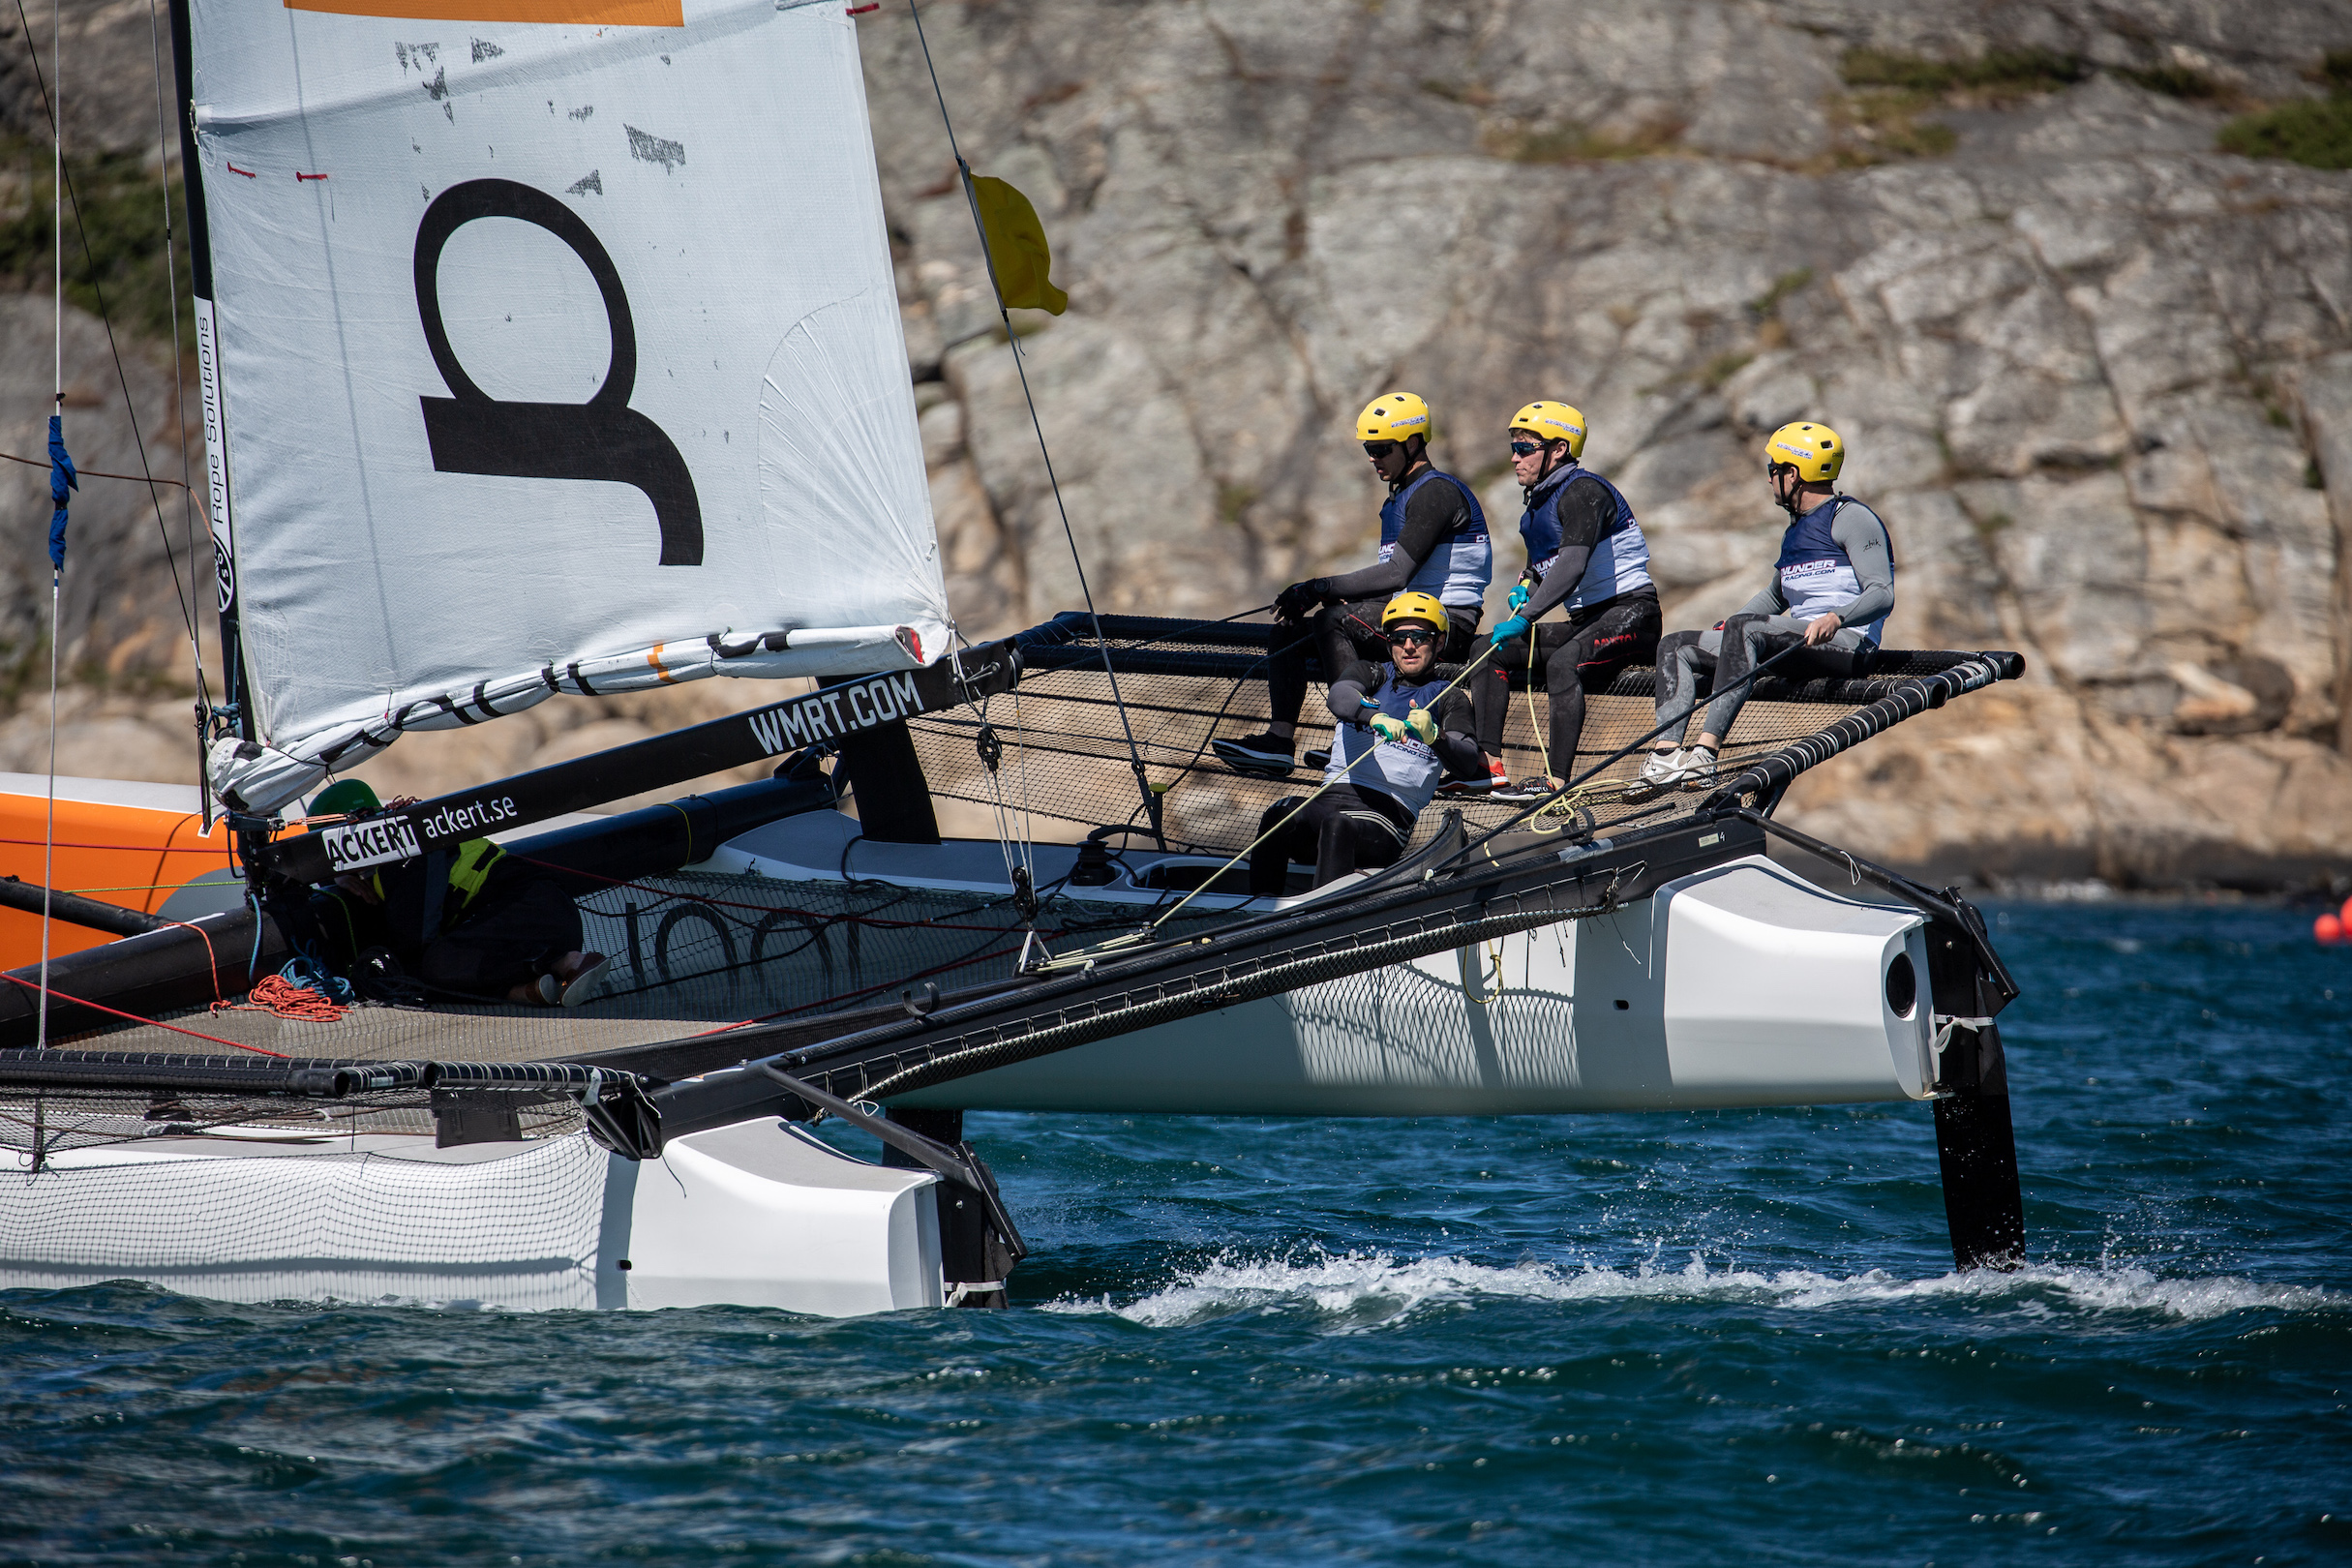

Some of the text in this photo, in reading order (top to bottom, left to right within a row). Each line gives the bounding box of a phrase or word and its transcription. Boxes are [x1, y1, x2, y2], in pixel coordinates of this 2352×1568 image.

[198, 316, 218, 443] Solutions
[211, 454, 225, 525] Rope
[1784, 568, 1836, 582] RACING.COM
[747, 671, 925, 755] WMRT.COM
[327, 796, 518, 865] ACKERT ackert.se
